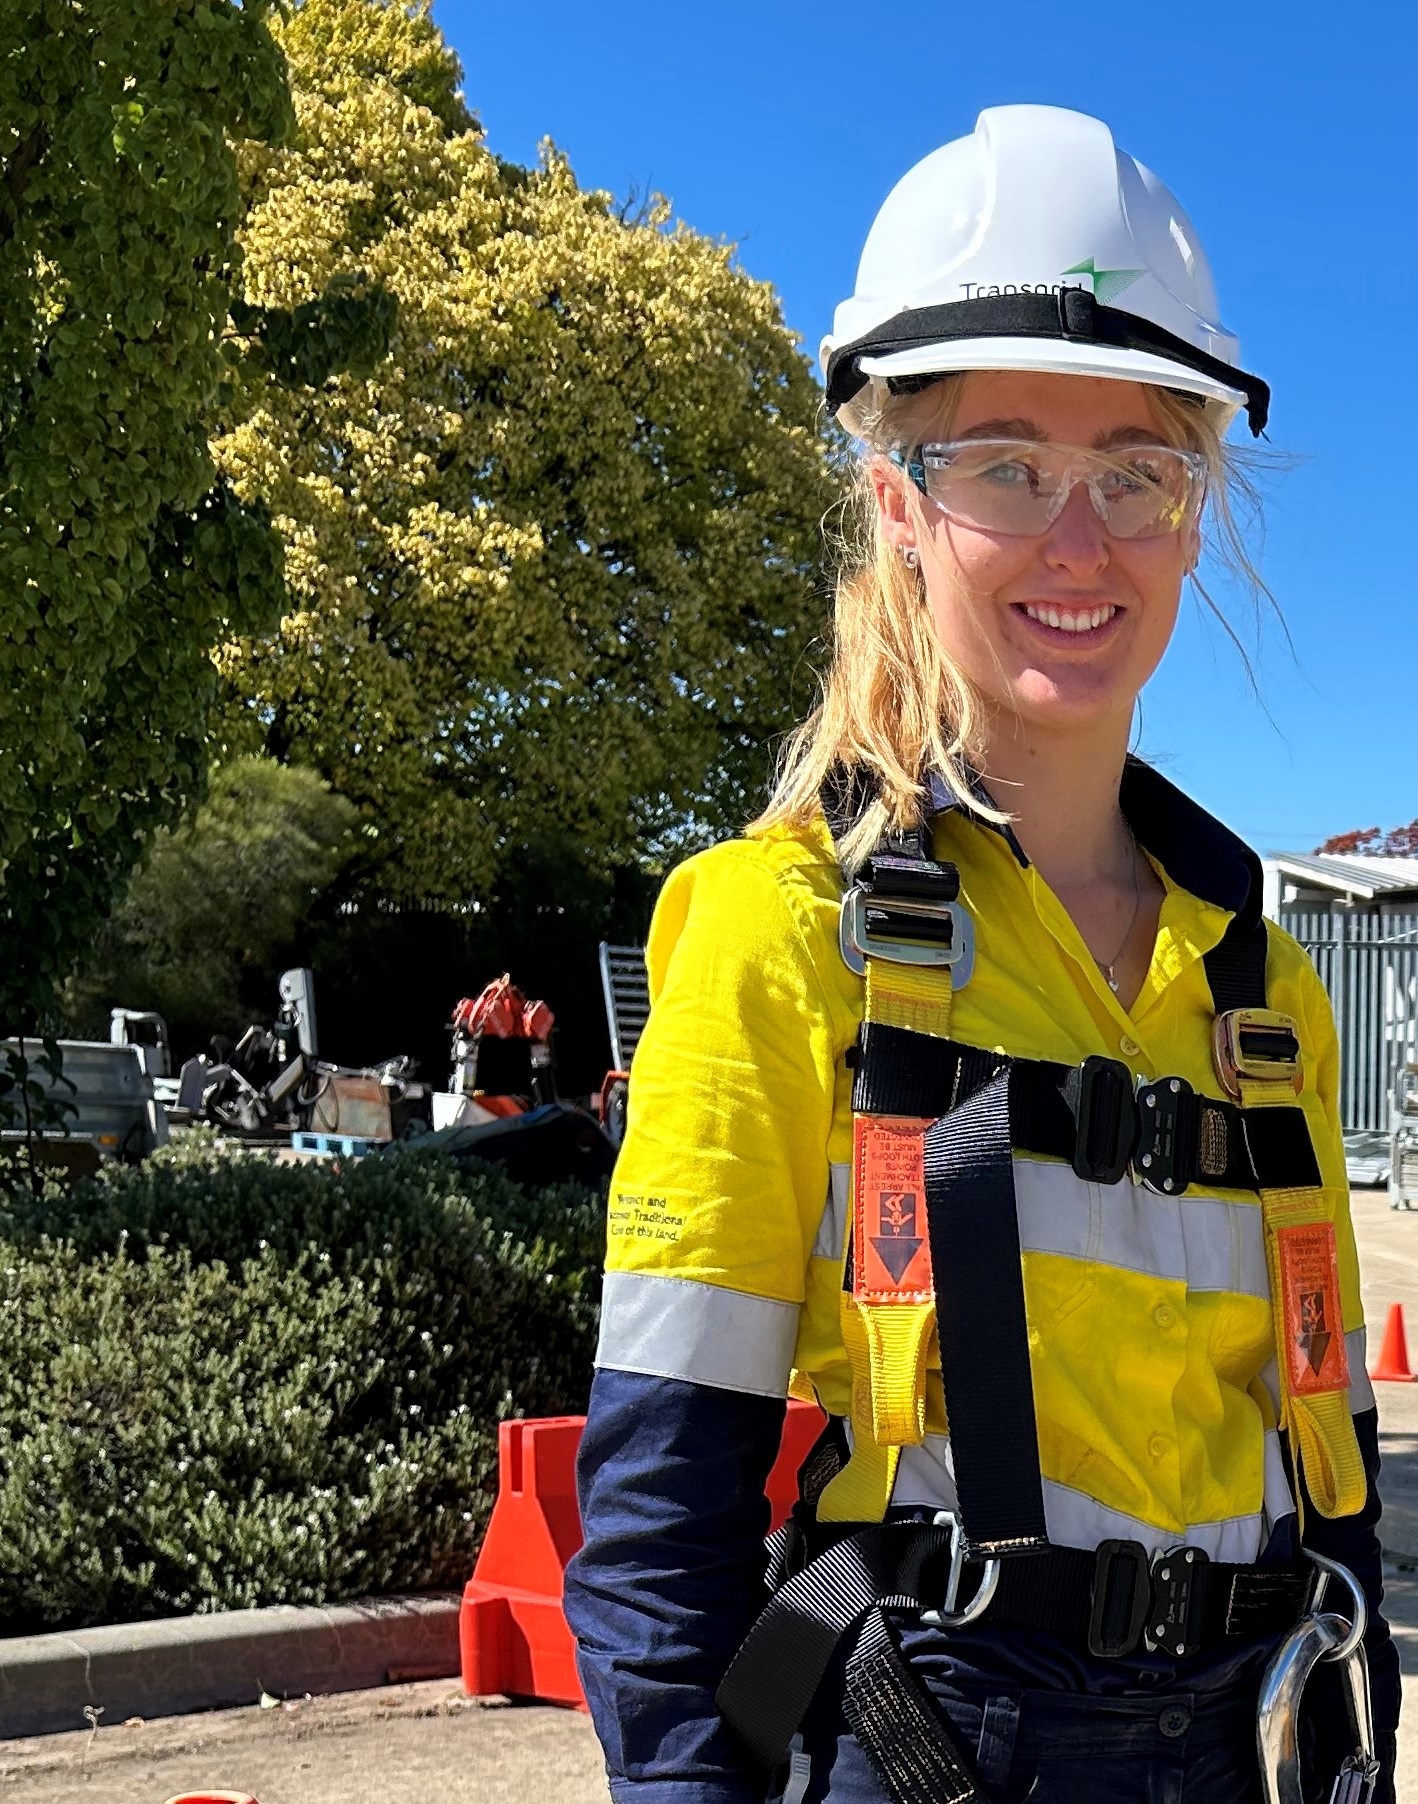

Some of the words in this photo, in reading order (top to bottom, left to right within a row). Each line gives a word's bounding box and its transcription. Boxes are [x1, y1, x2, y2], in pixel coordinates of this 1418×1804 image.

[959, 281, 1082, 299] Transr
[870, 1173, 921, 1181] TTACHMENT
[647, 1197, 666, 1208] and
[634, 1208, 687, 1226] Traditional
